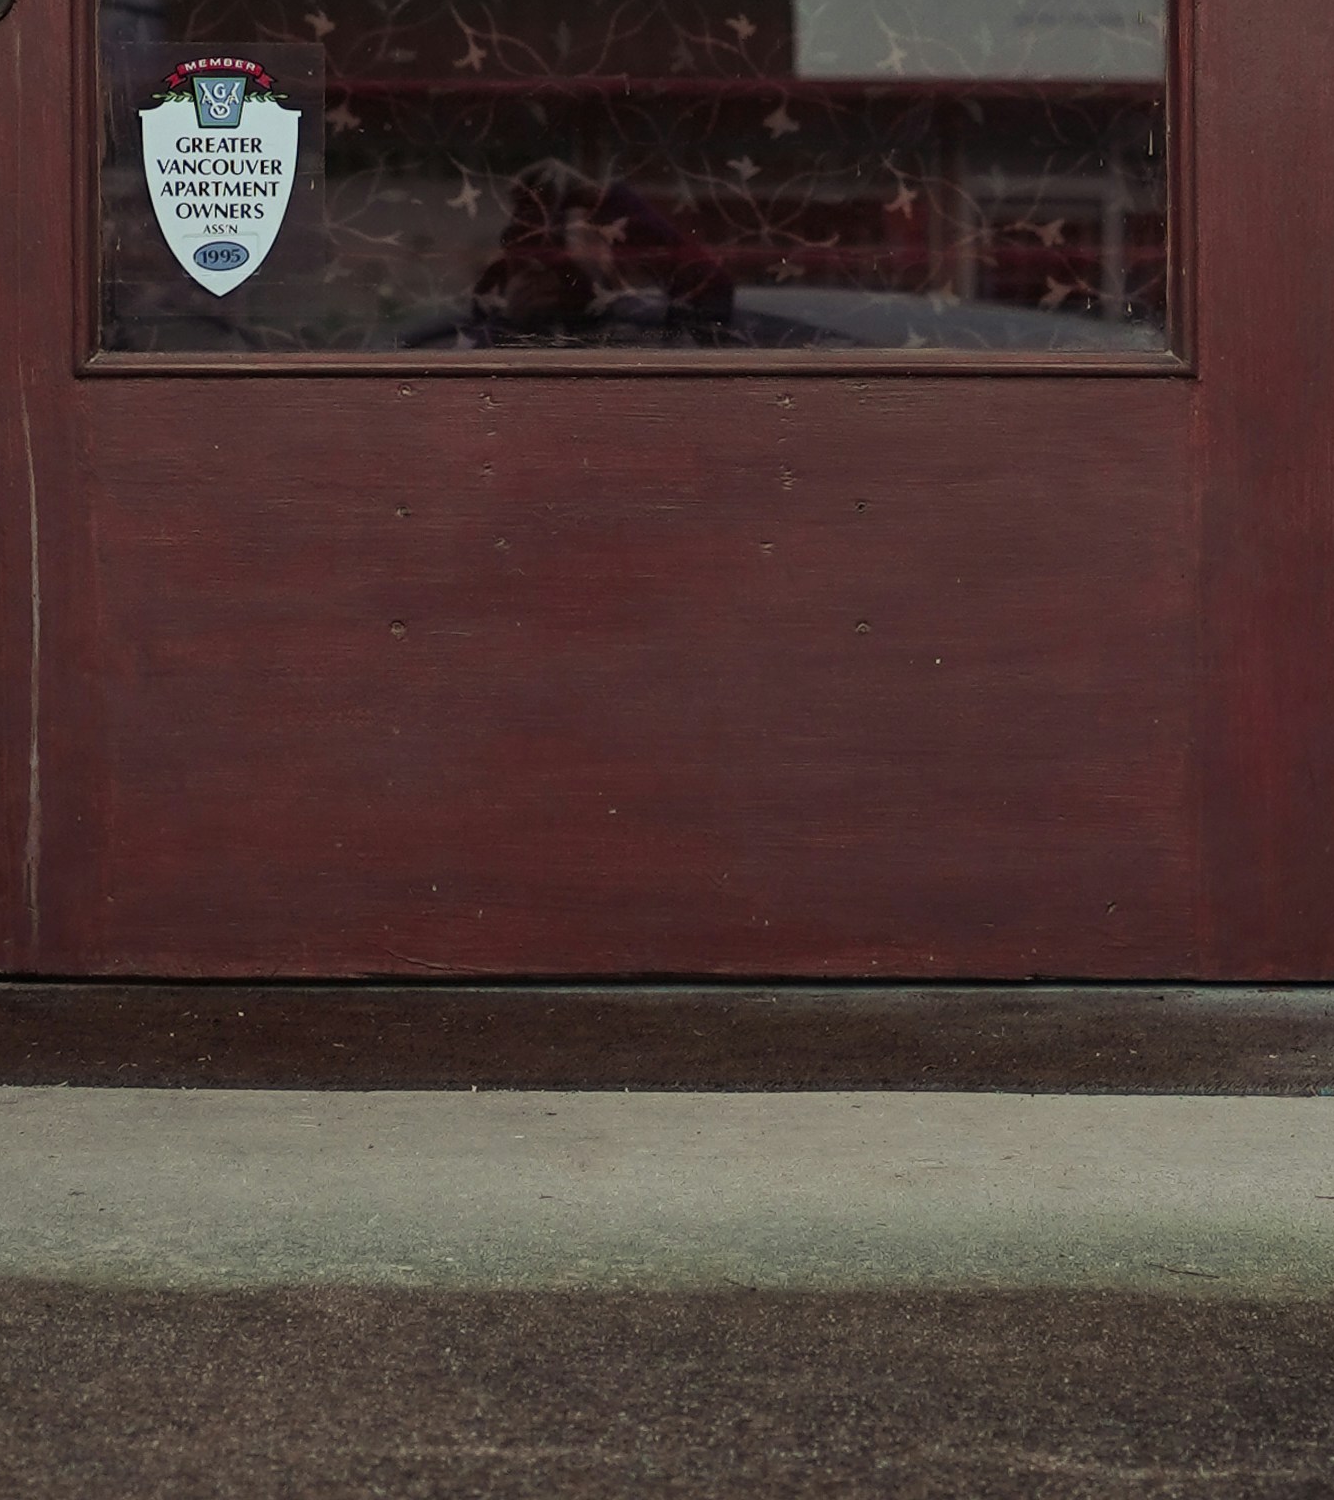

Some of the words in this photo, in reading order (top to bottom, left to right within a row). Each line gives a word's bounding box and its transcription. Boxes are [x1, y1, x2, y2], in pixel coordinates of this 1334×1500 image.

[184, 58, 256, 72] MEMBER
[175, 136, 263, 154] GREATER
[156, 158, 283, 176] VANCOUVER
[160, 180, 280, 198] APARTMENT
[175, 202, 264, 220] OWNERS
[203, 224, 238, 235] ASS'N
[200, 247, 242, 265] 1995
